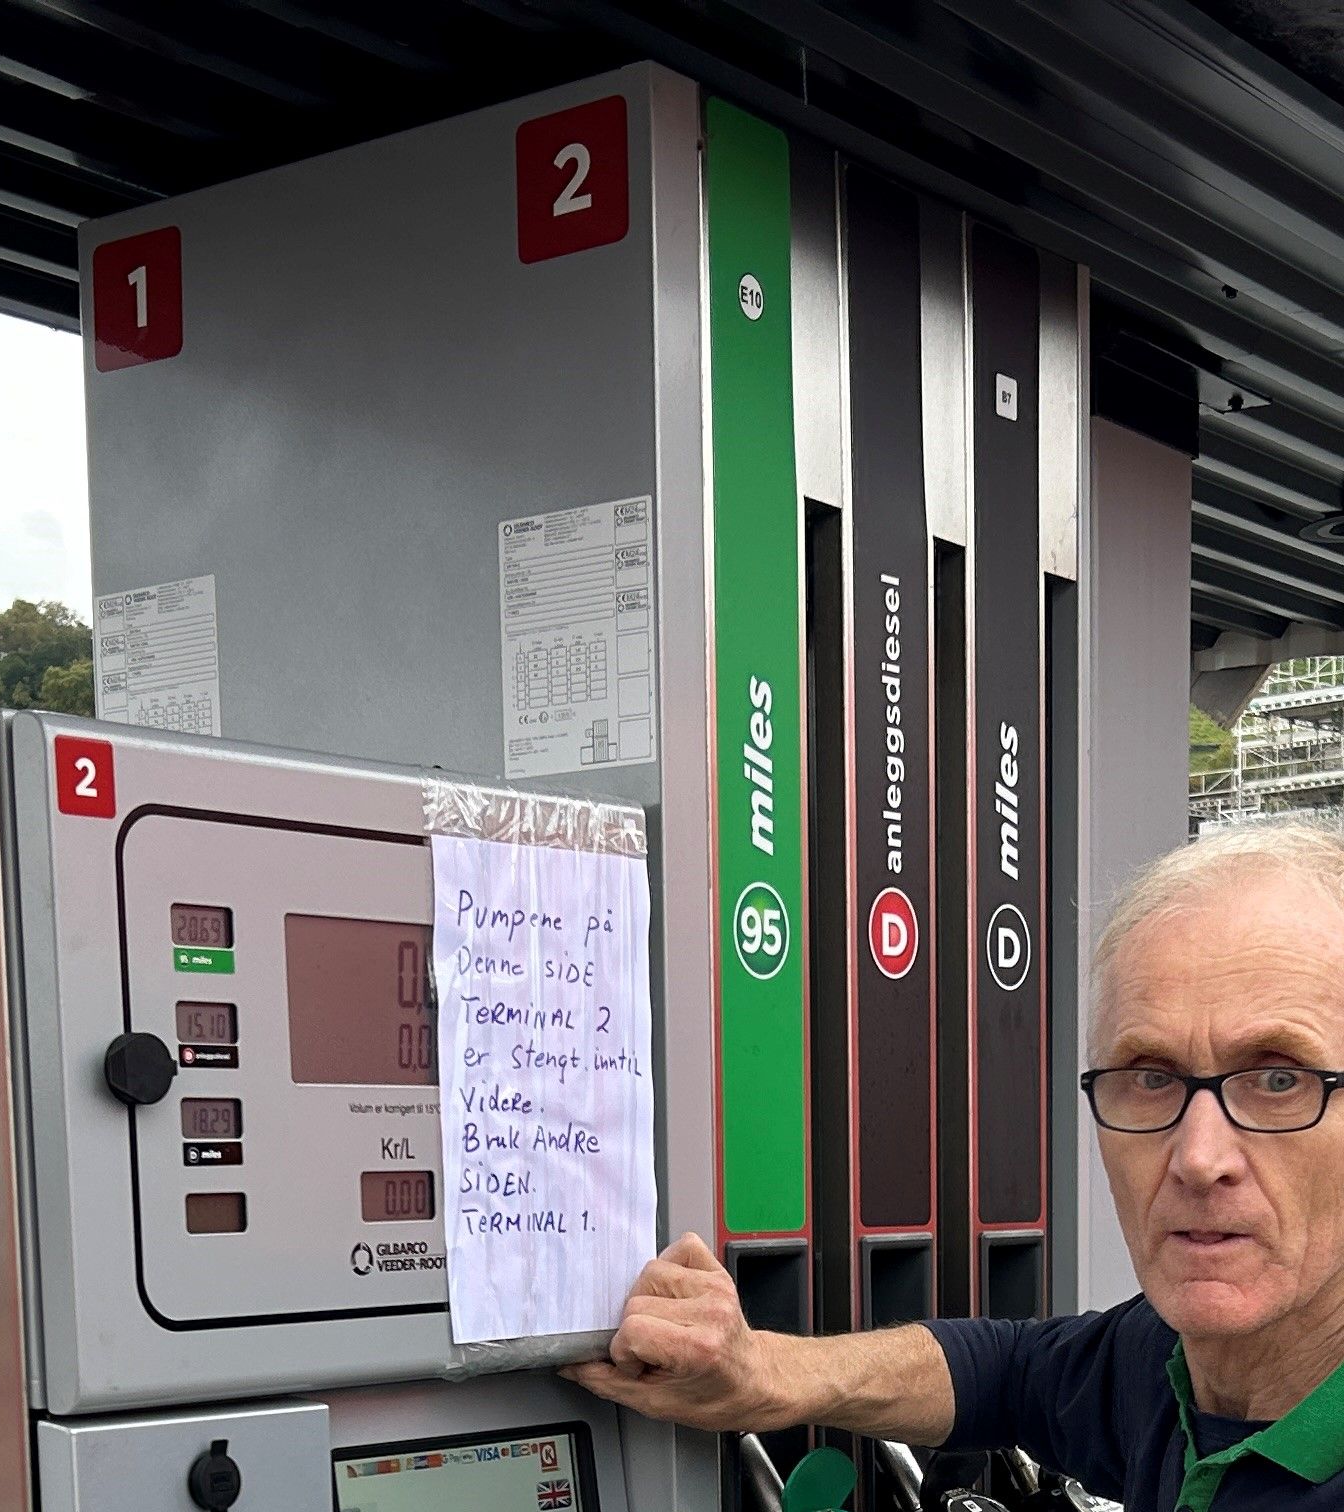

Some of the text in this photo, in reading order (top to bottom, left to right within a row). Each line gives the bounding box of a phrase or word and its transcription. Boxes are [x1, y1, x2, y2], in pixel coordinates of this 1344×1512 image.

[552, 141, 592, 217] 2
[127, 265, 148, 328] 1
[740, 285, 762, 309] E10
[74, 757, 98, 798] 2
[880, 573, 908, 957] anleggsdiesel D
[741, 675, 782, 955] miles 95
[994, 721, 1021, 968] miles D
[457, 889, 613, 947] Pumpene på
[458, 945, 524, 977] Denne
[596, 1006, 611, 1034] 2
[463, 1046, 490, 1068] er
[381, 1136, 416, 1160] Kr/L
[462, 1122, 520, 1153] Bruk
[377, 1241, 428, 1256] GILBARCO
[474, 1446, 501, 1463] VISA
